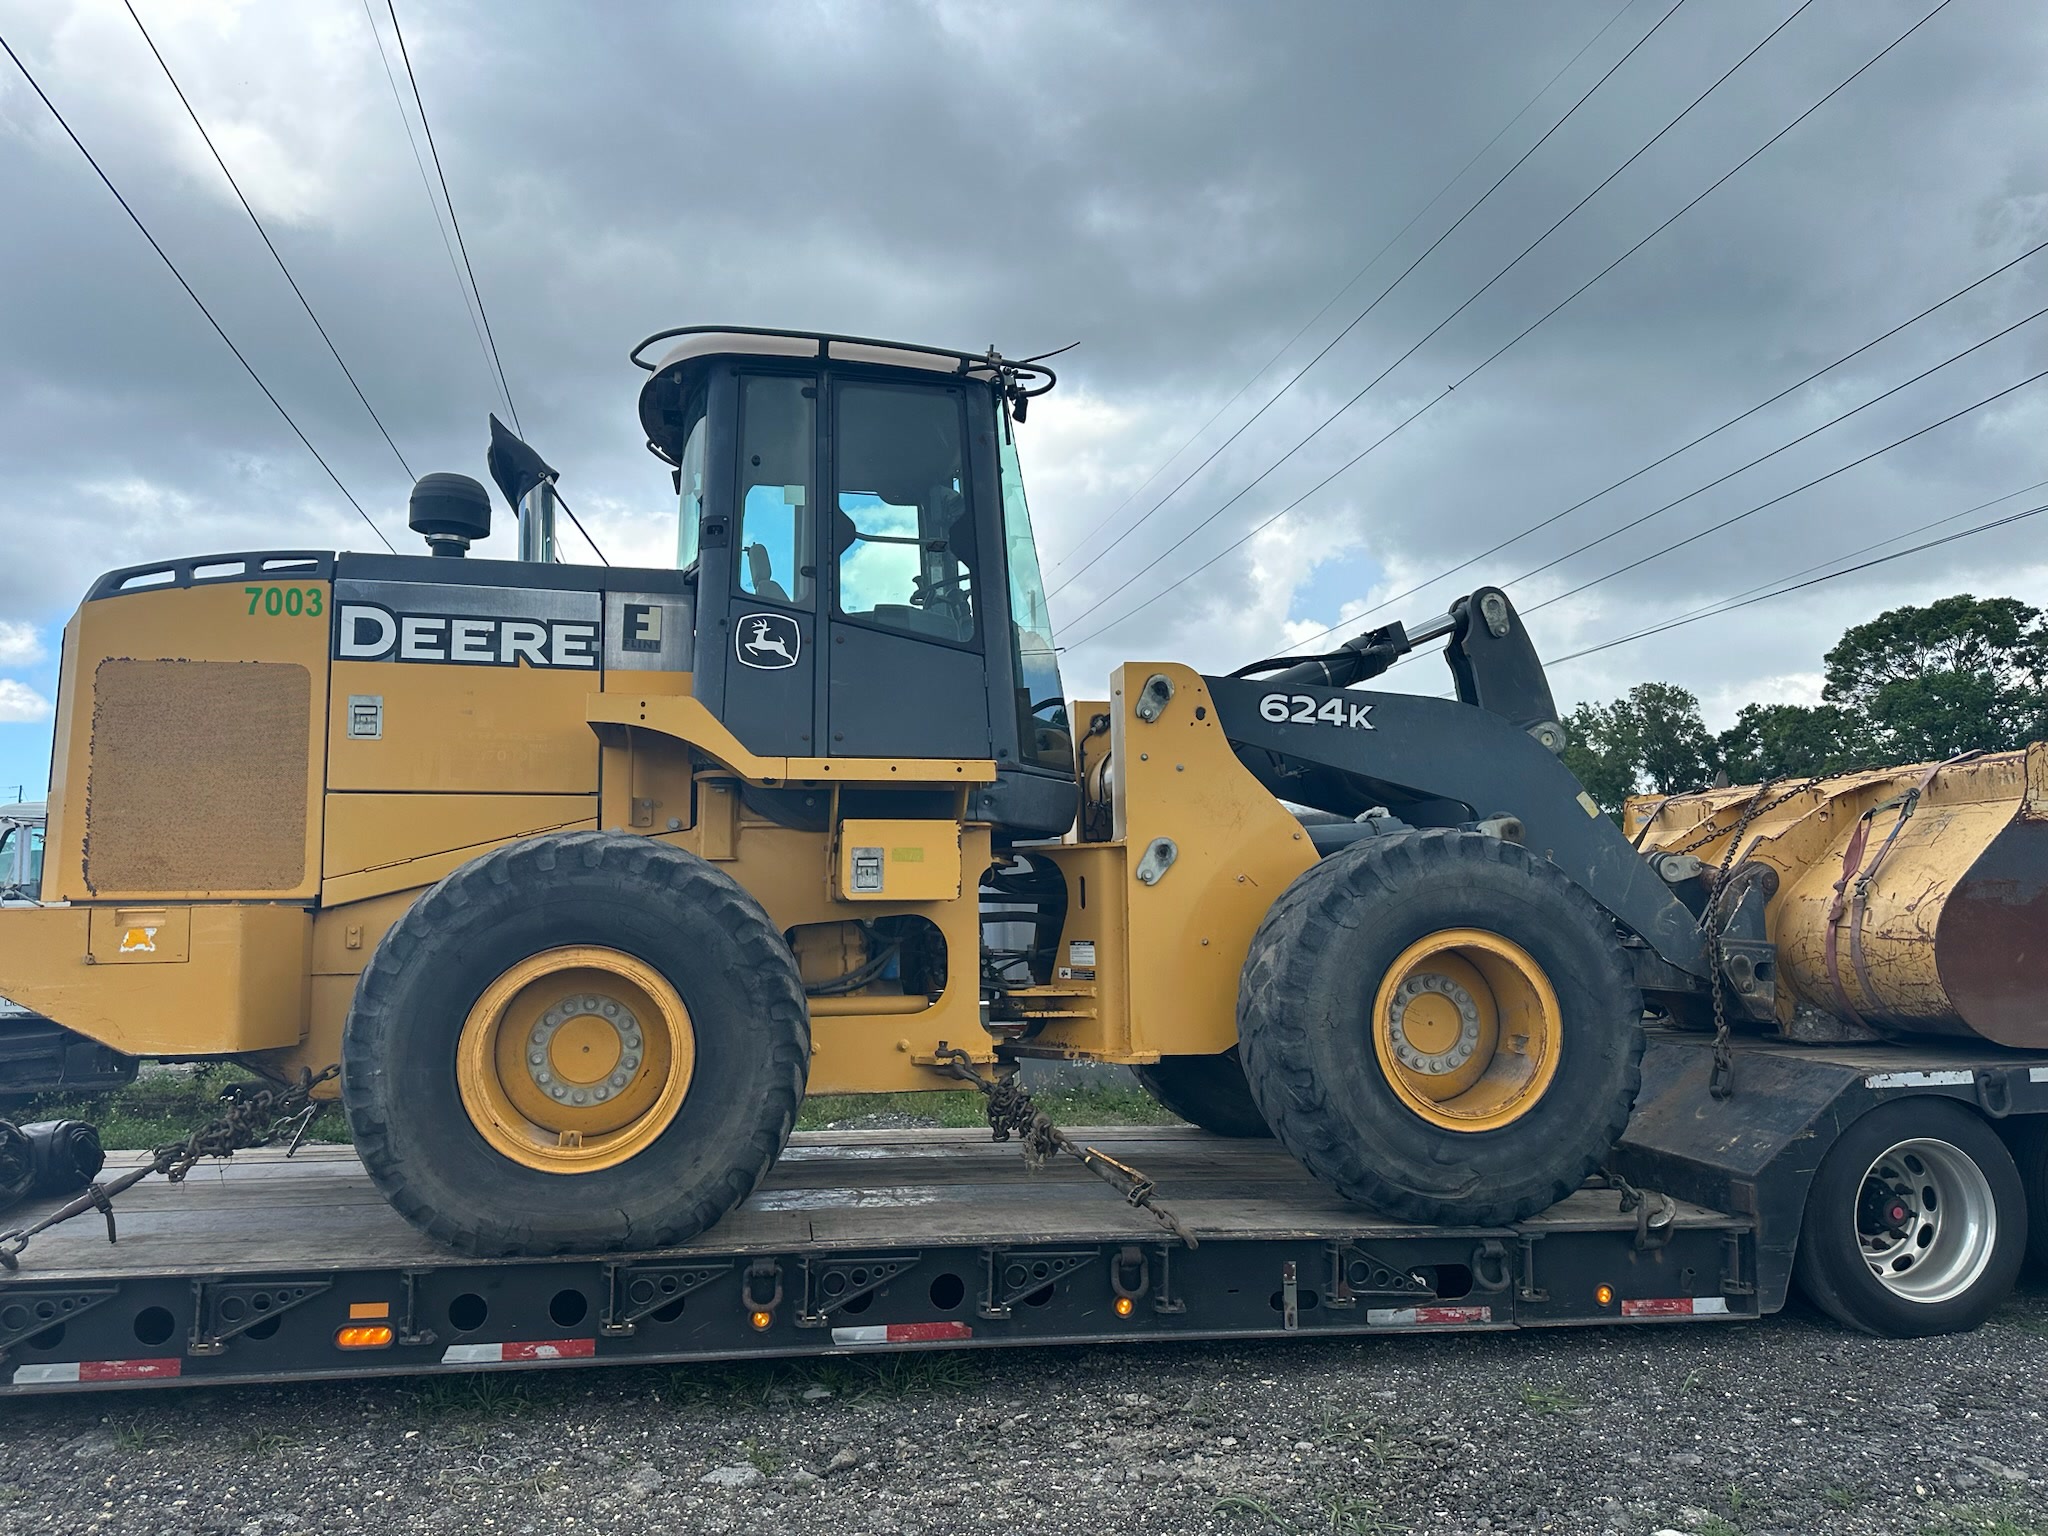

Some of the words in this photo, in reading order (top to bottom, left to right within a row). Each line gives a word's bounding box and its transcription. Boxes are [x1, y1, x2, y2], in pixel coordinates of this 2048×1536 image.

[245, 587, 323, 617] 7003
[339, 605, 596, 666] DEERE
[624, 639, 660, 650] FLINT
[1260, 693, 1375, 730] 624K
